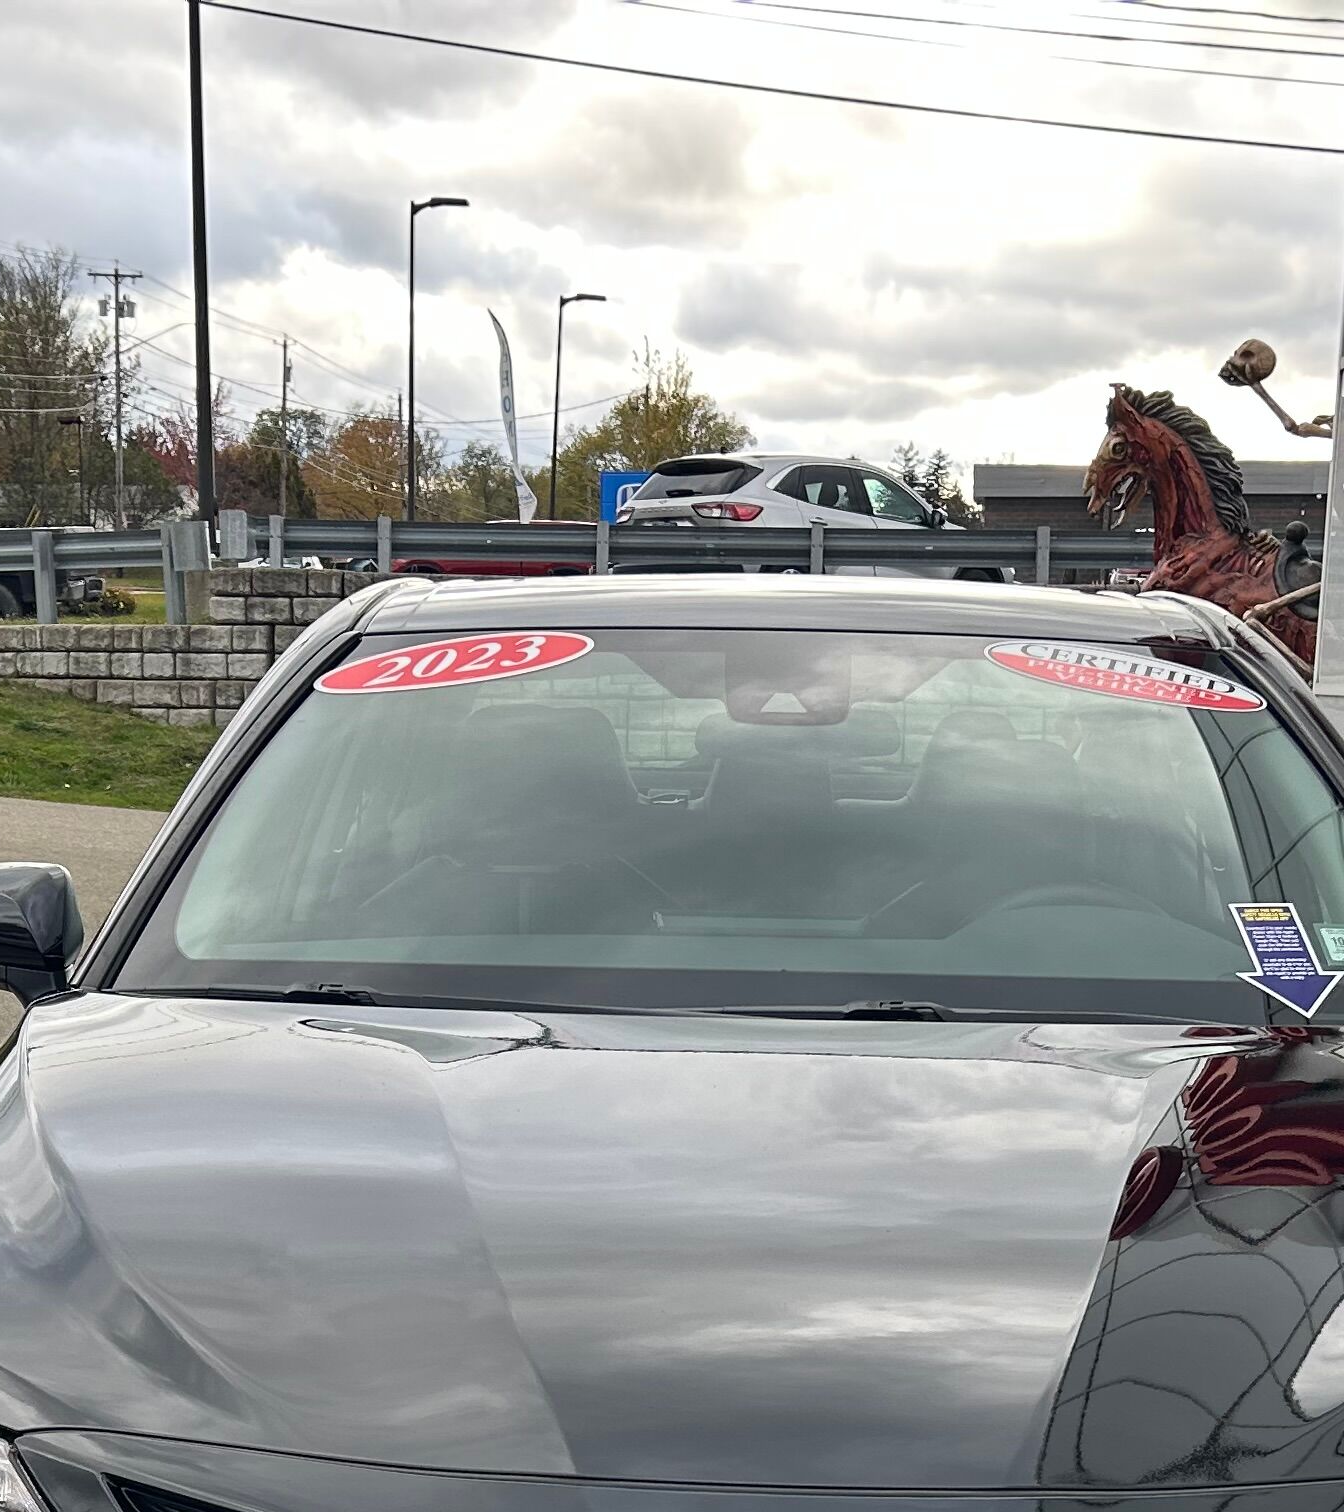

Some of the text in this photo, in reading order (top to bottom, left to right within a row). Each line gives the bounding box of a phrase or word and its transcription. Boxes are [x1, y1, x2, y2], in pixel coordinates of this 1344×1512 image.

[362, 635, 548, 688] 2023
[1020, 643, 1236, 694] CERTIFIED
[1026, 659, 1222, 701] PRE-OWNED
[1054, 671, 1192, 703] VEHICLE
